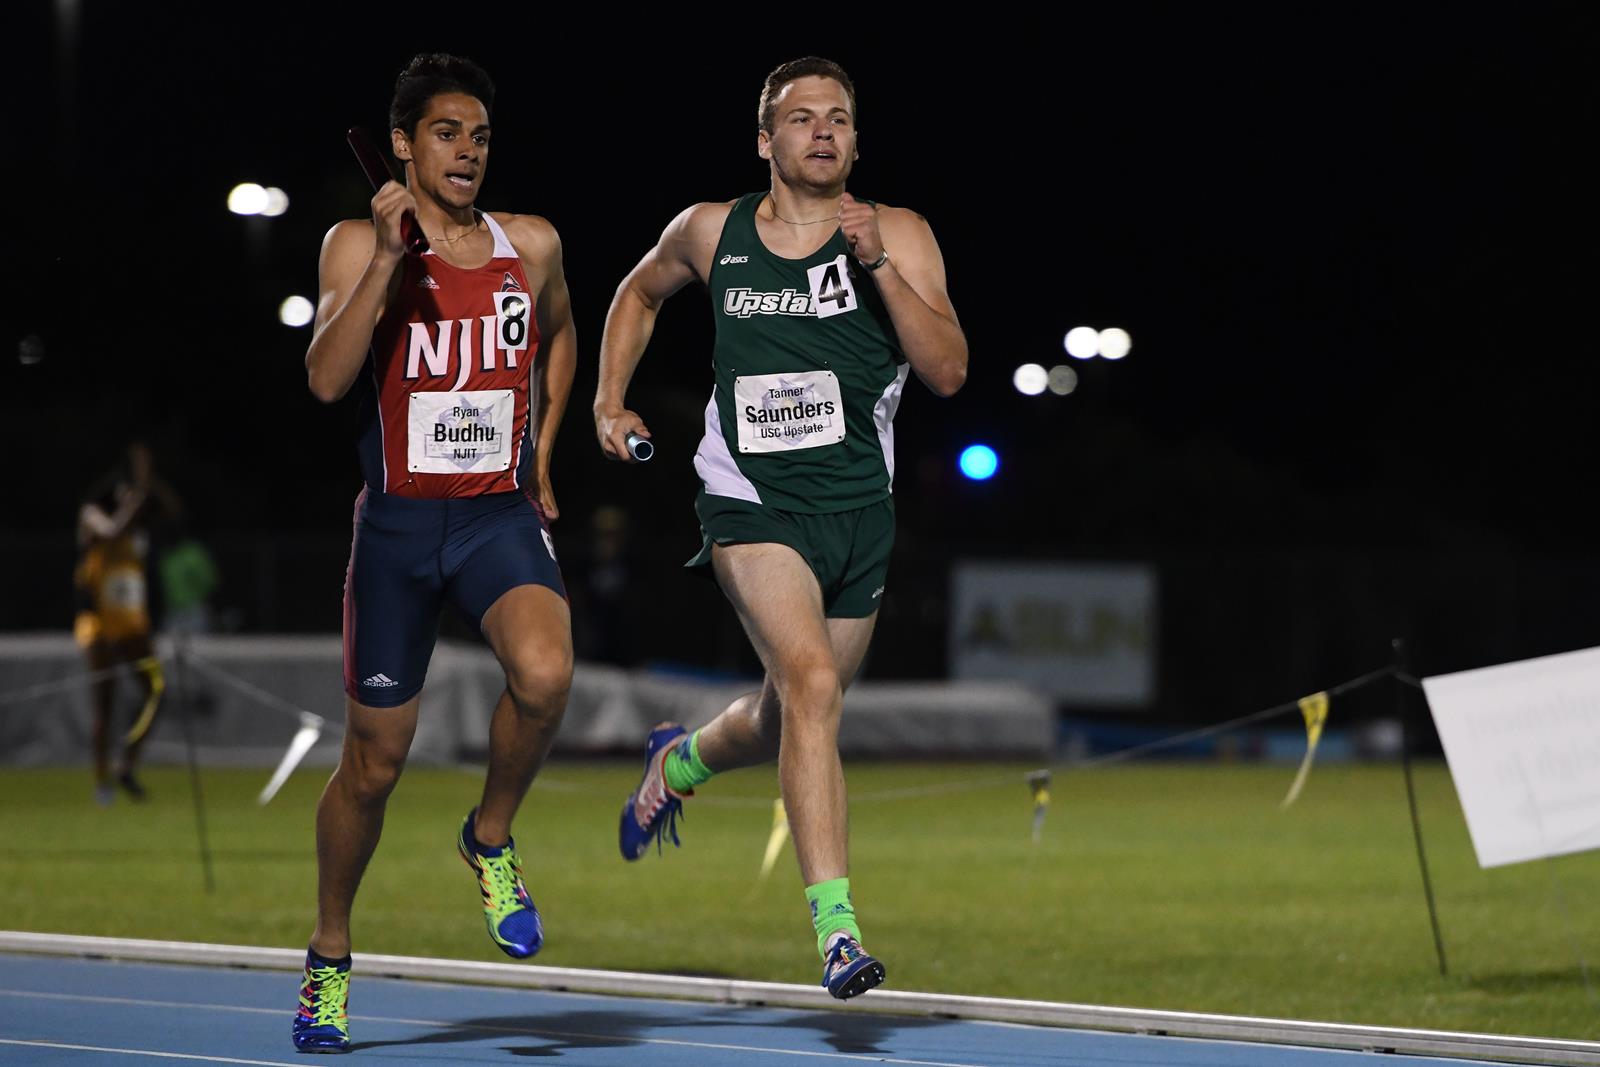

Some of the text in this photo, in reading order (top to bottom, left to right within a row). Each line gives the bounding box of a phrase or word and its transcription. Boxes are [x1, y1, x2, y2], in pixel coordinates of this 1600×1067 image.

[818, 264, 849, 309] 4
[502, 295, 526, 346] 8
[768, 387, 805, 399] Tanner
[453, 406, 479, 419] Ryan
[745, 401, 835, 423] Saunders
[434, 423, 495, 442] Budhu
[761, 423, 824, 438] USC Upstate
[453, 448, 477, 459] NJIT
